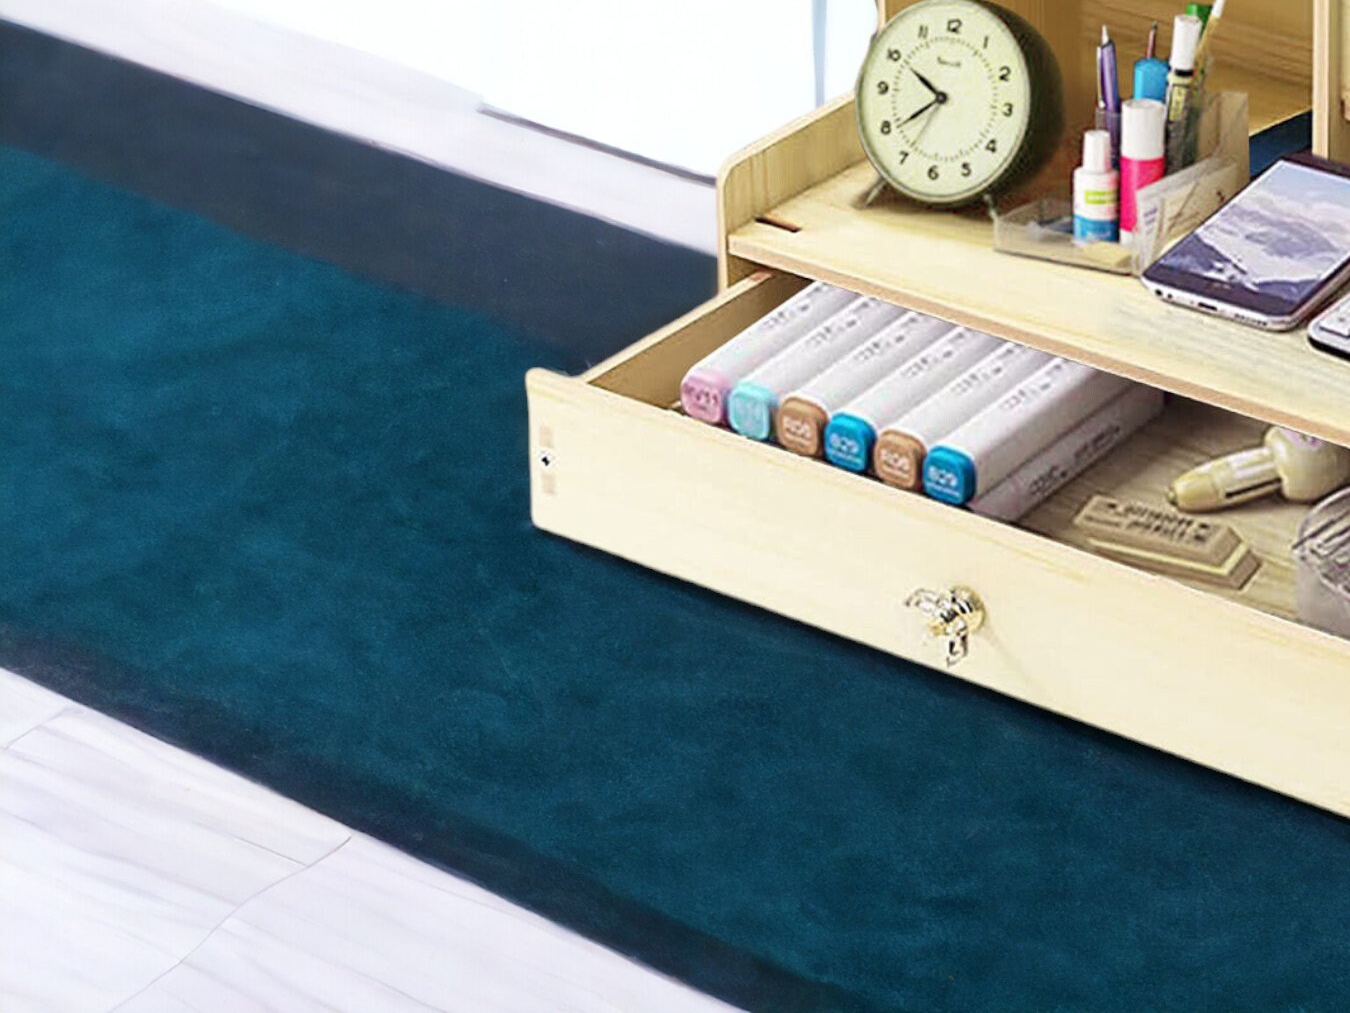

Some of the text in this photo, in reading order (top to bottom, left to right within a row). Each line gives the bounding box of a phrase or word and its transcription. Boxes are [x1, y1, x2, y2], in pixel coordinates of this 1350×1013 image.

[946, 18, 963, 34] 12
[983, 36, 989, 50] 1
[998, 66, 1012, 82] 2
[876, 81, 889, 95] 9
[1002, 102, 1014, 118] 3
[880, 120, 892, 136] 8
[985, 139, 998, 154] 4
[898, 150, 910, 166] 7
[927, 164, 940, 180] 6
[960, 162, 972, 177] 5
